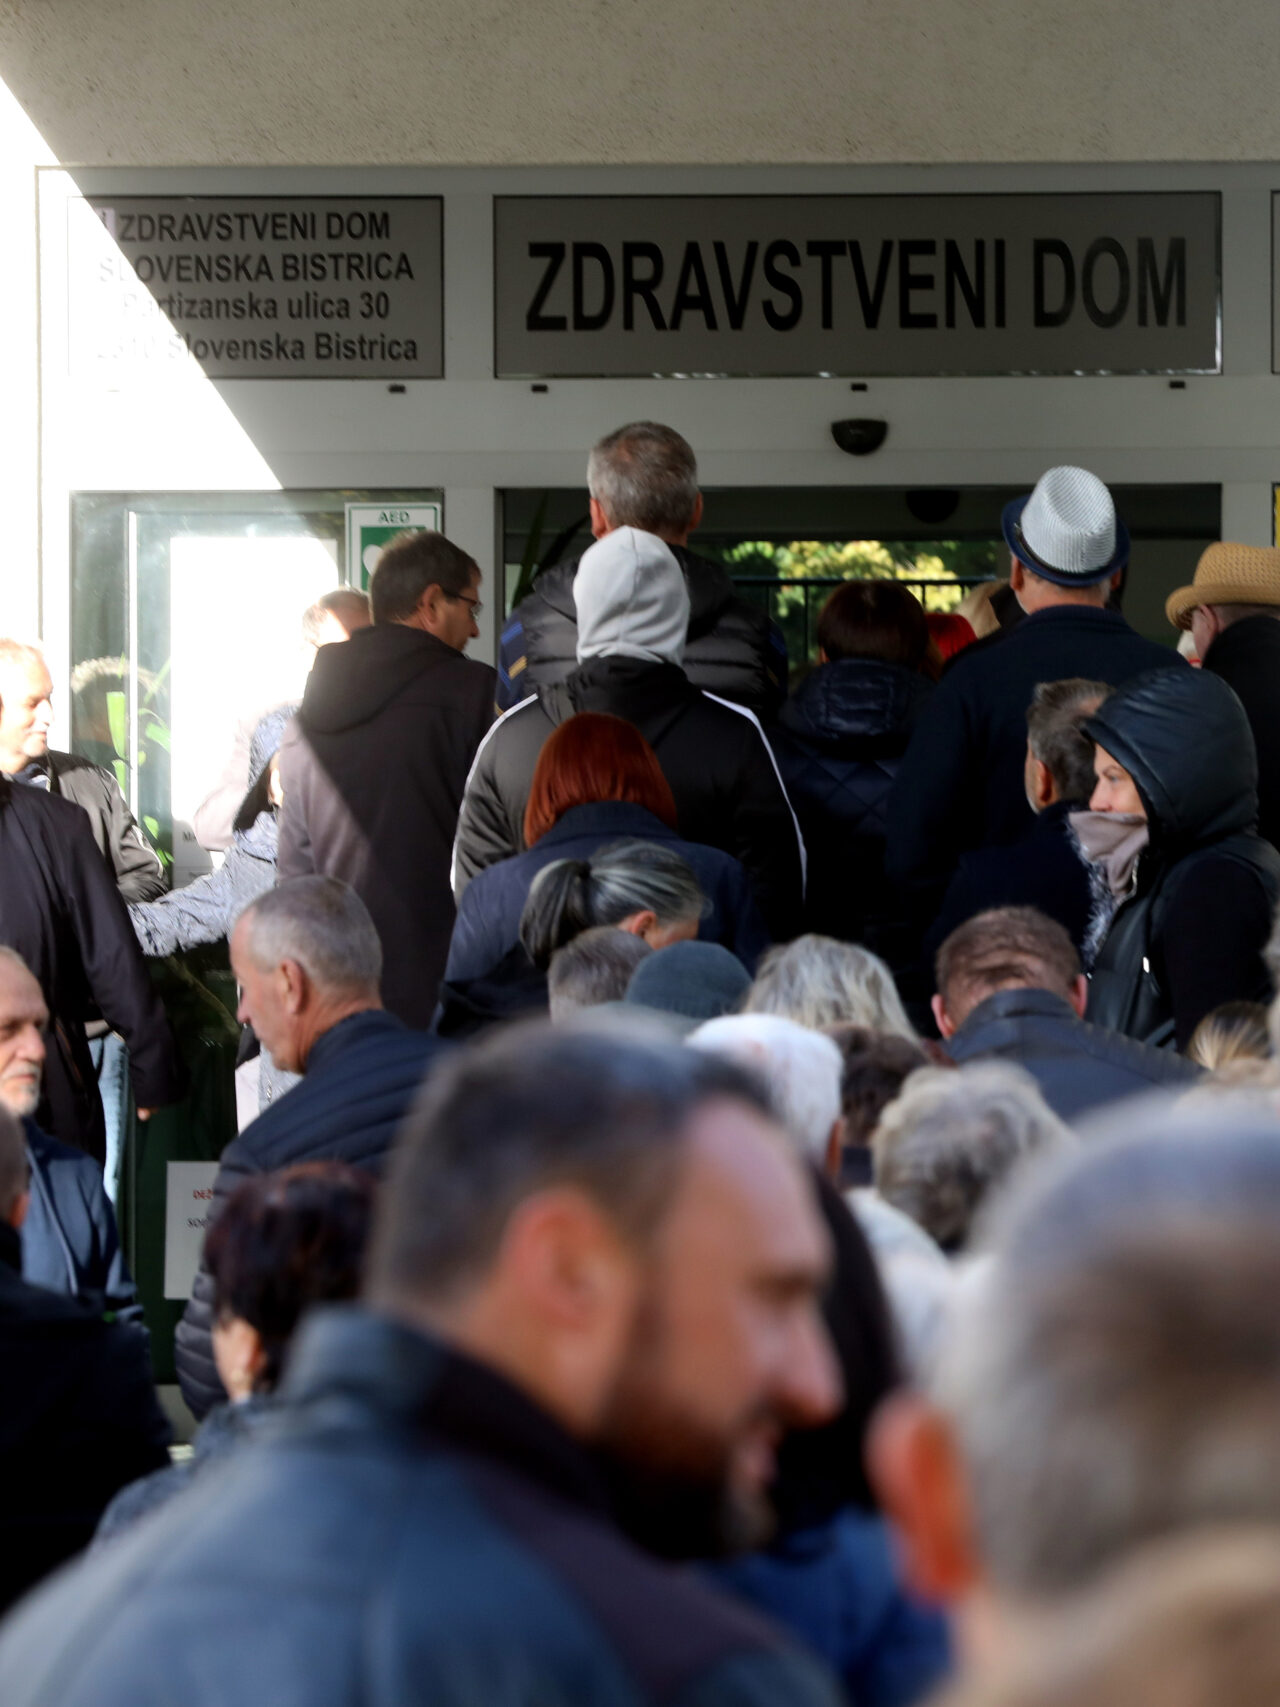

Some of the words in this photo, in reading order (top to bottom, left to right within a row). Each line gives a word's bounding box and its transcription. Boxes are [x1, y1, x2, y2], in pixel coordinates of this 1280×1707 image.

[119, 212, 316, 242] ZDRAVSTVENI
[326, 211, 391, 241] DOM
[282, 252, 415, 282] BISTRICA
[525, 239, 1007, 332] ZDRAVSTVENI
[1032, 236, 1188, 329] DOM
[287, 291, 351, 320] ulica
[360, 291, 390, 319] 30
[314, 332, 418, 361] Bistrica
[379, 510, 410, 523] AED
